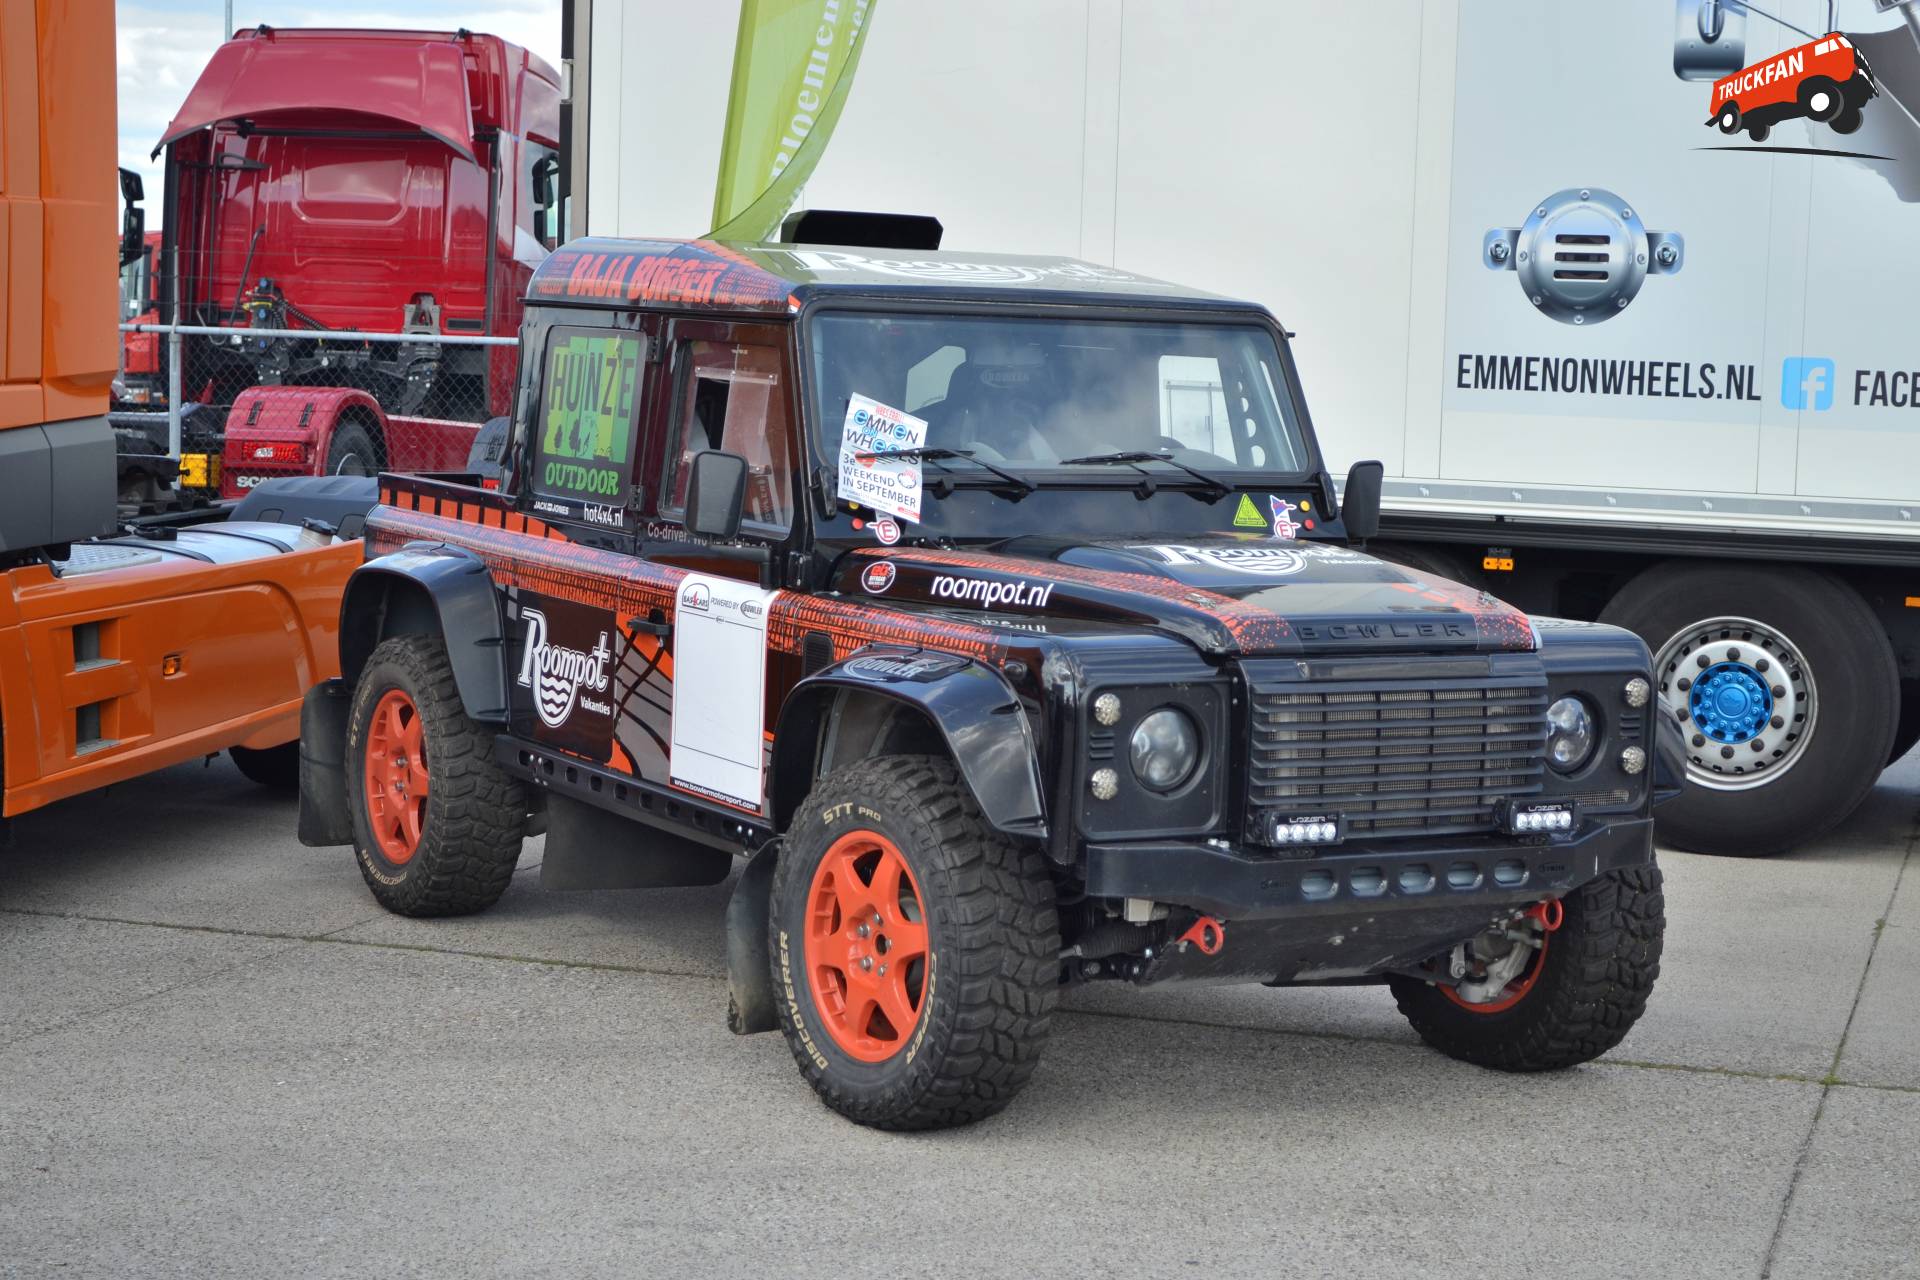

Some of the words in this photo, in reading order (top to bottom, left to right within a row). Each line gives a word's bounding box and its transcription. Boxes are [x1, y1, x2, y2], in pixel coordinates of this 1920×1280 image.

[567, 254, 635, 297] BAJA
[550, 352, 635, 419] HUNZE
[1457, 354, 1761, 401] EMMENONWHEELS.NL
[862, 426, 877, 438] ON
[844, 453, 855, 465] 3e
[545, 462, 619, 496] OUTDOOR
[843, 465, 895, 487] WEEKEND
[843, 476, 854, 487] IN
[857, 480, 916, 509] SEPTEMBER
[584, 502, 623, 527] hot4x4.nl
[711, 597, 731, 609] POWERED
[732, 602, 740, 610] BY
[931, 576, 1054, 607] roompot.nl
[1296, 624, 1466, 641] BOWLER
[518, 606, 610, 728] Roompot
[580, 696, 610, 716] Vakanties
[674, 779, 756, 811] www.bowlermotorsport.com
[823, 802, 853, 824] STT
[858, 806, 881, 823] PRO
[780, 931, 829, 1071] DISCOVERER
[905, 951, 938, 1065] COOPER
